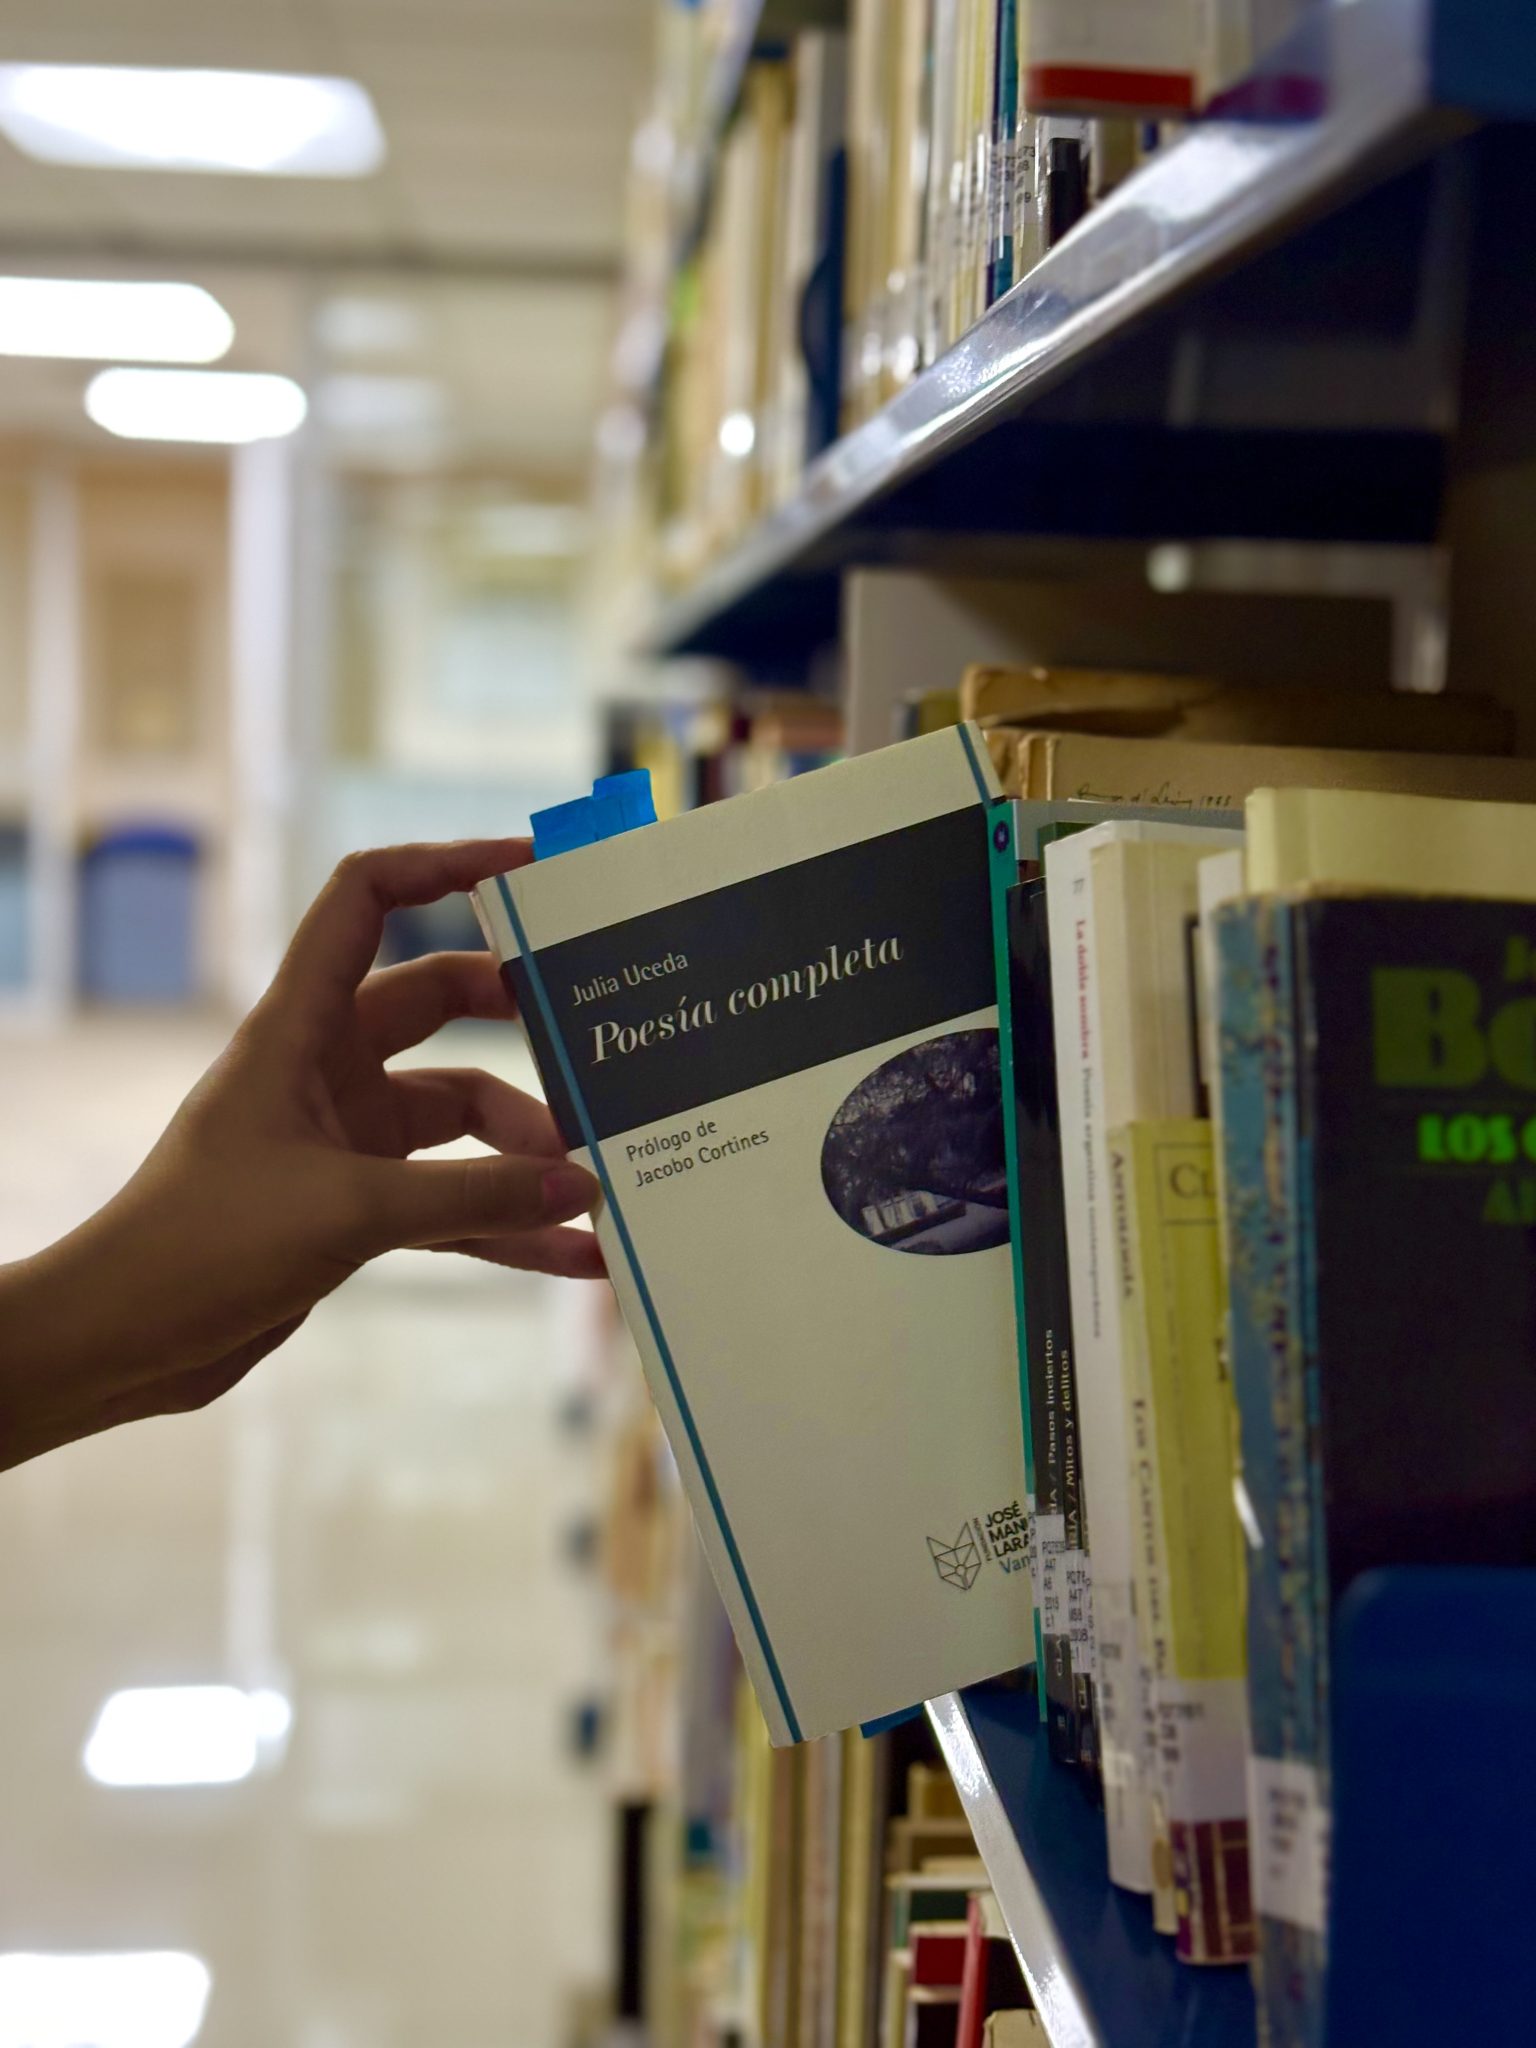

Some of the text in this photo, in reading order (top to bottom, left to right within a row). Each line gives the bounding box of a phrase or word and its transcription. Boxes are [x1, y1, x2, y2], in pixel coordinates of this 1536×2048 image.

[572, 952, 689, 1006] Julia Uceda
[588, 936, 905, 1064] Poesía completa
[625, 1120, 718, 1162] Prólogo de
[636, 1129, 770, 1187] Jacobo Cortines
[1060, 1350, 1072, 1411] delitos
[1047, 1410, 1057, 1464] Pasos
[1065, 1435, 1076, 1486] Mitos
[985, 1500, 1022, 1528] JOSÉ
[988, 1518, 1029, 1543] MAN
